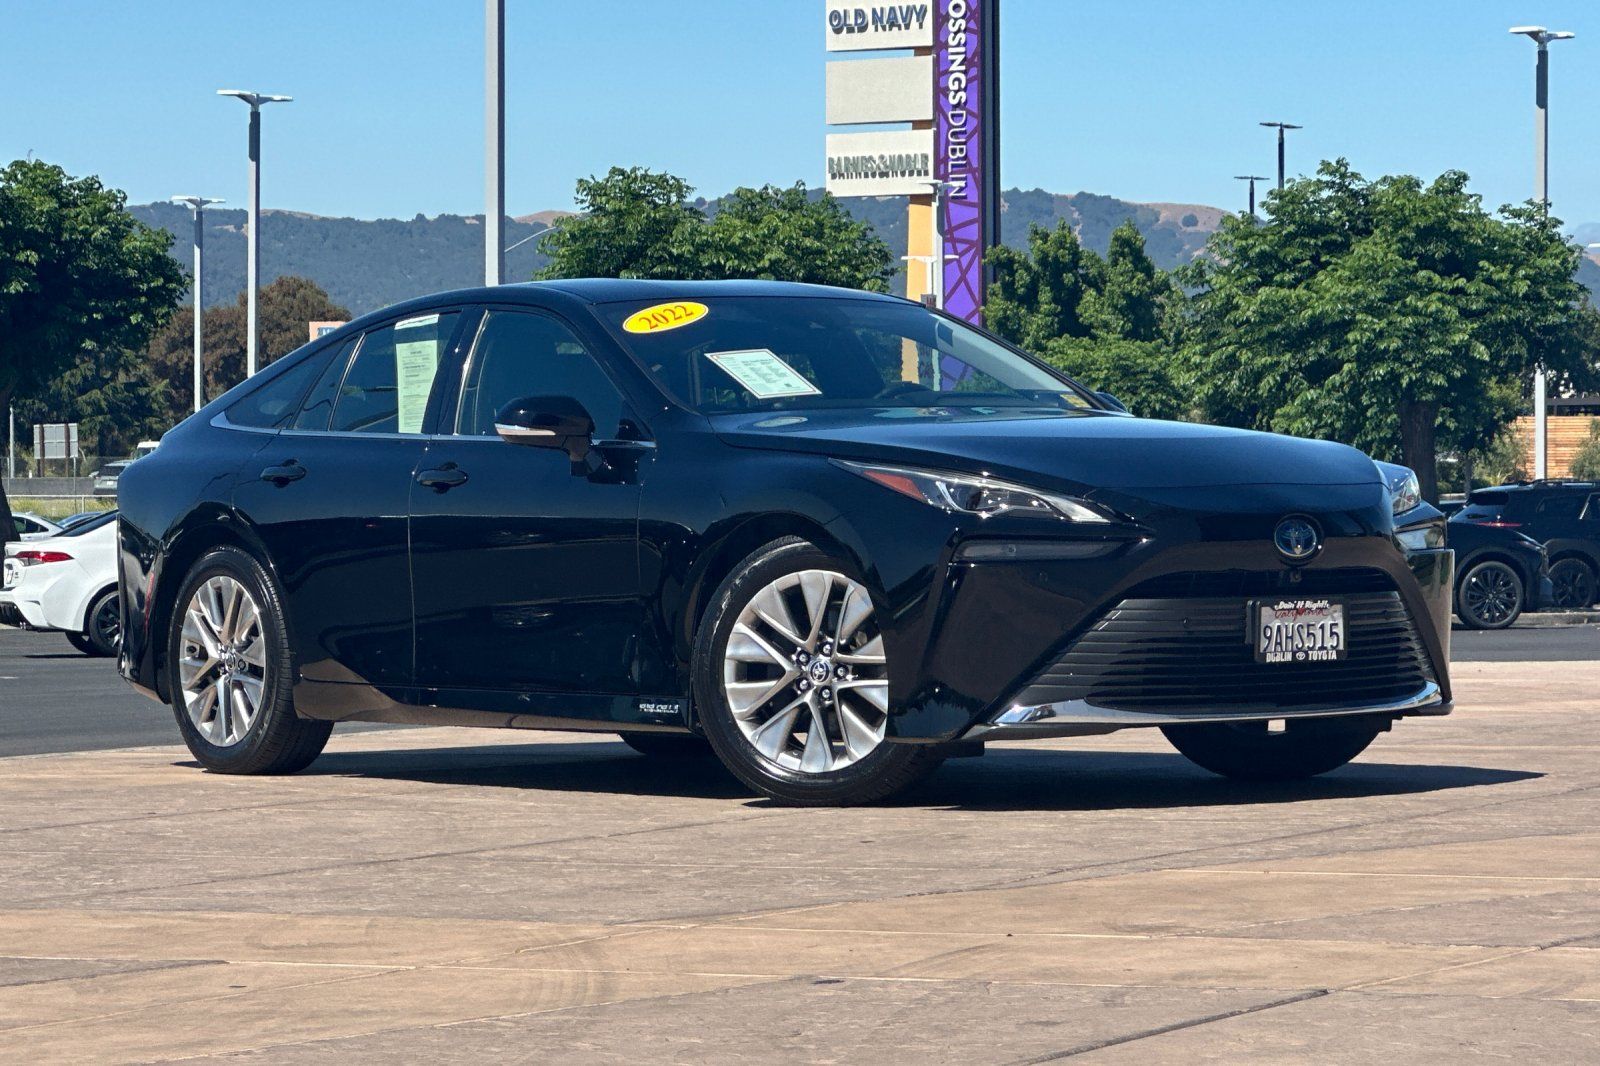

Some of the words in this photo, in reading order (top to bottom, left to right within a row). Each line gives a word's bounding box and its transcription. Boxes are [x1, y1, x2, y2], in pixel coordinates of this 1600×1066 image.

[829, 8, 868, 31] OLD
[871, 4, 928, 29] NAVY
[947, 0, 967, 106] OSSINGS
[947, 110, 968, 198] DUBLIN
[638, 304, 694, 330] 2022
[1263, 622, 1340, 652] 9AHS515
[1266, 651, 1293, 662] DUBLIN
[1308, 650, 1337, 661] TOYOTA
